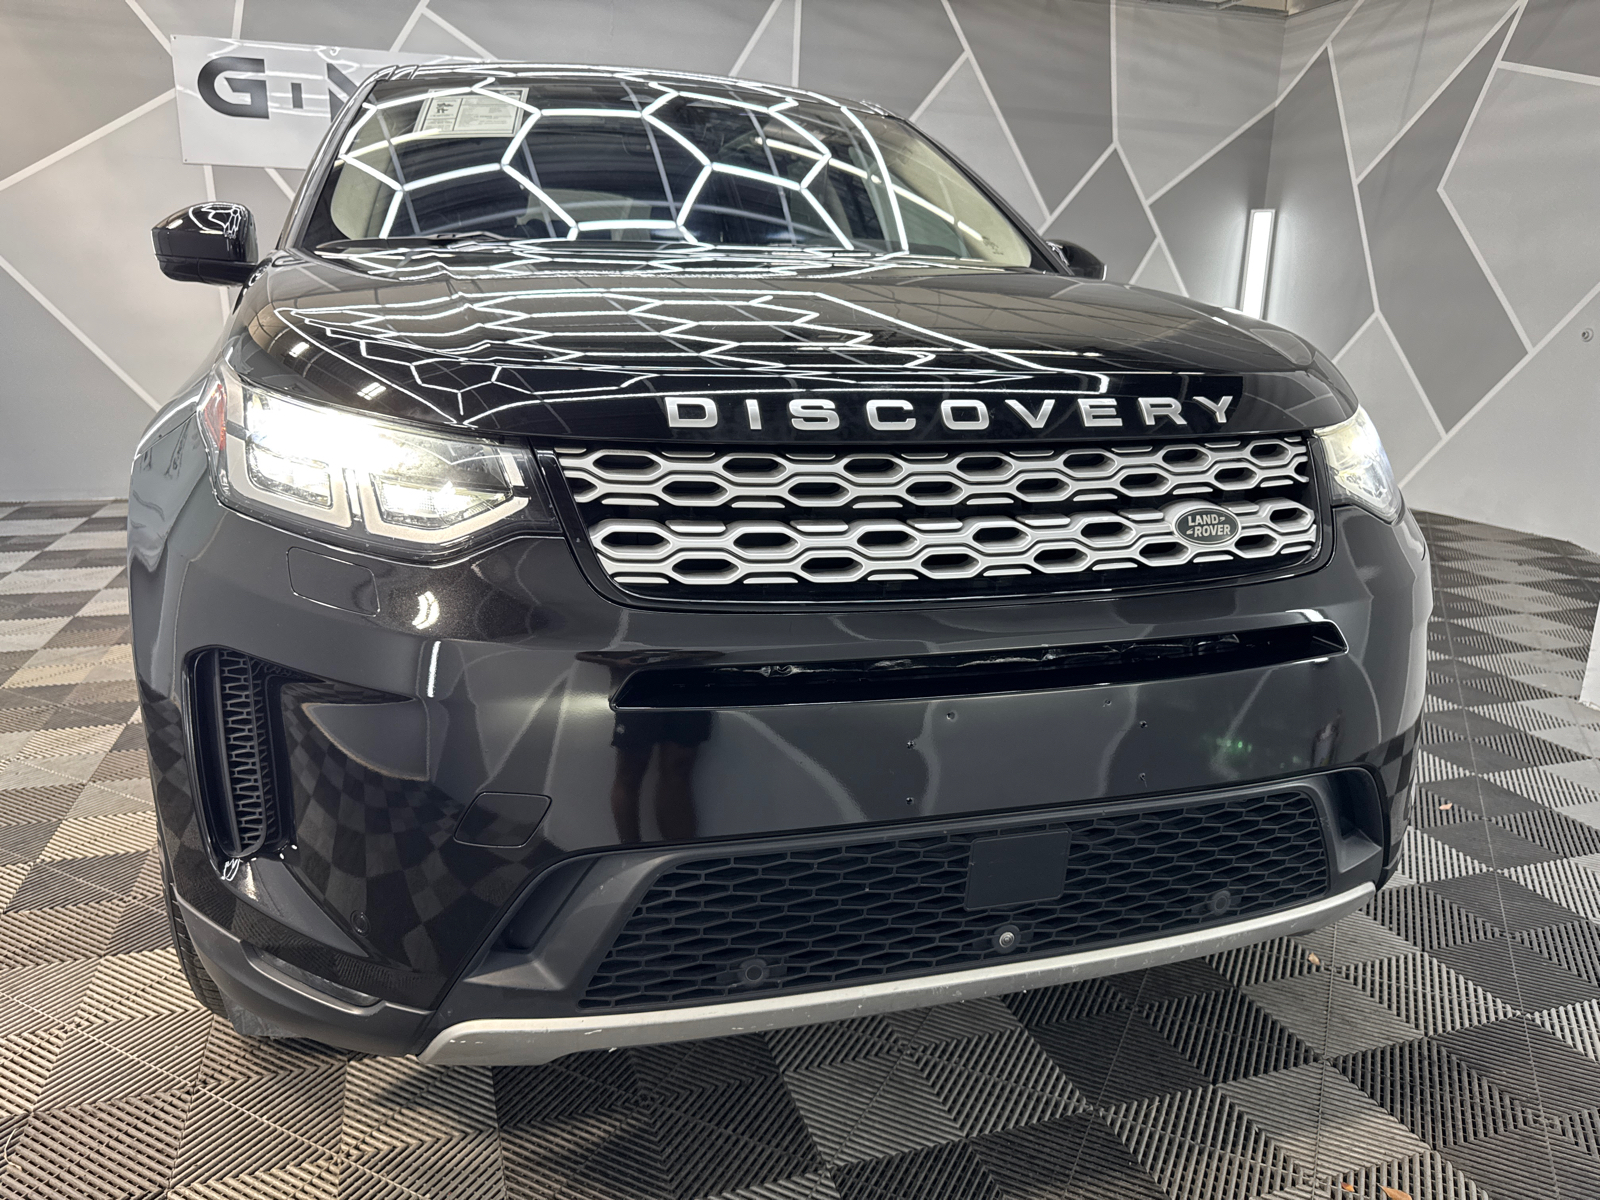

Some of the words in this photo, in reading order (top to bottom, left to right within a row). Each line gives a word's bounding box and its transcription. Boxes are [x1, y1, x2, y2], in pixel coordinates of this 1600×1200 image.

[664, 395, 1233, 430] DISCOVERY
[1188, 514, 1219, 526] LAND
[1194, 524, 1231, 538] ROVER
